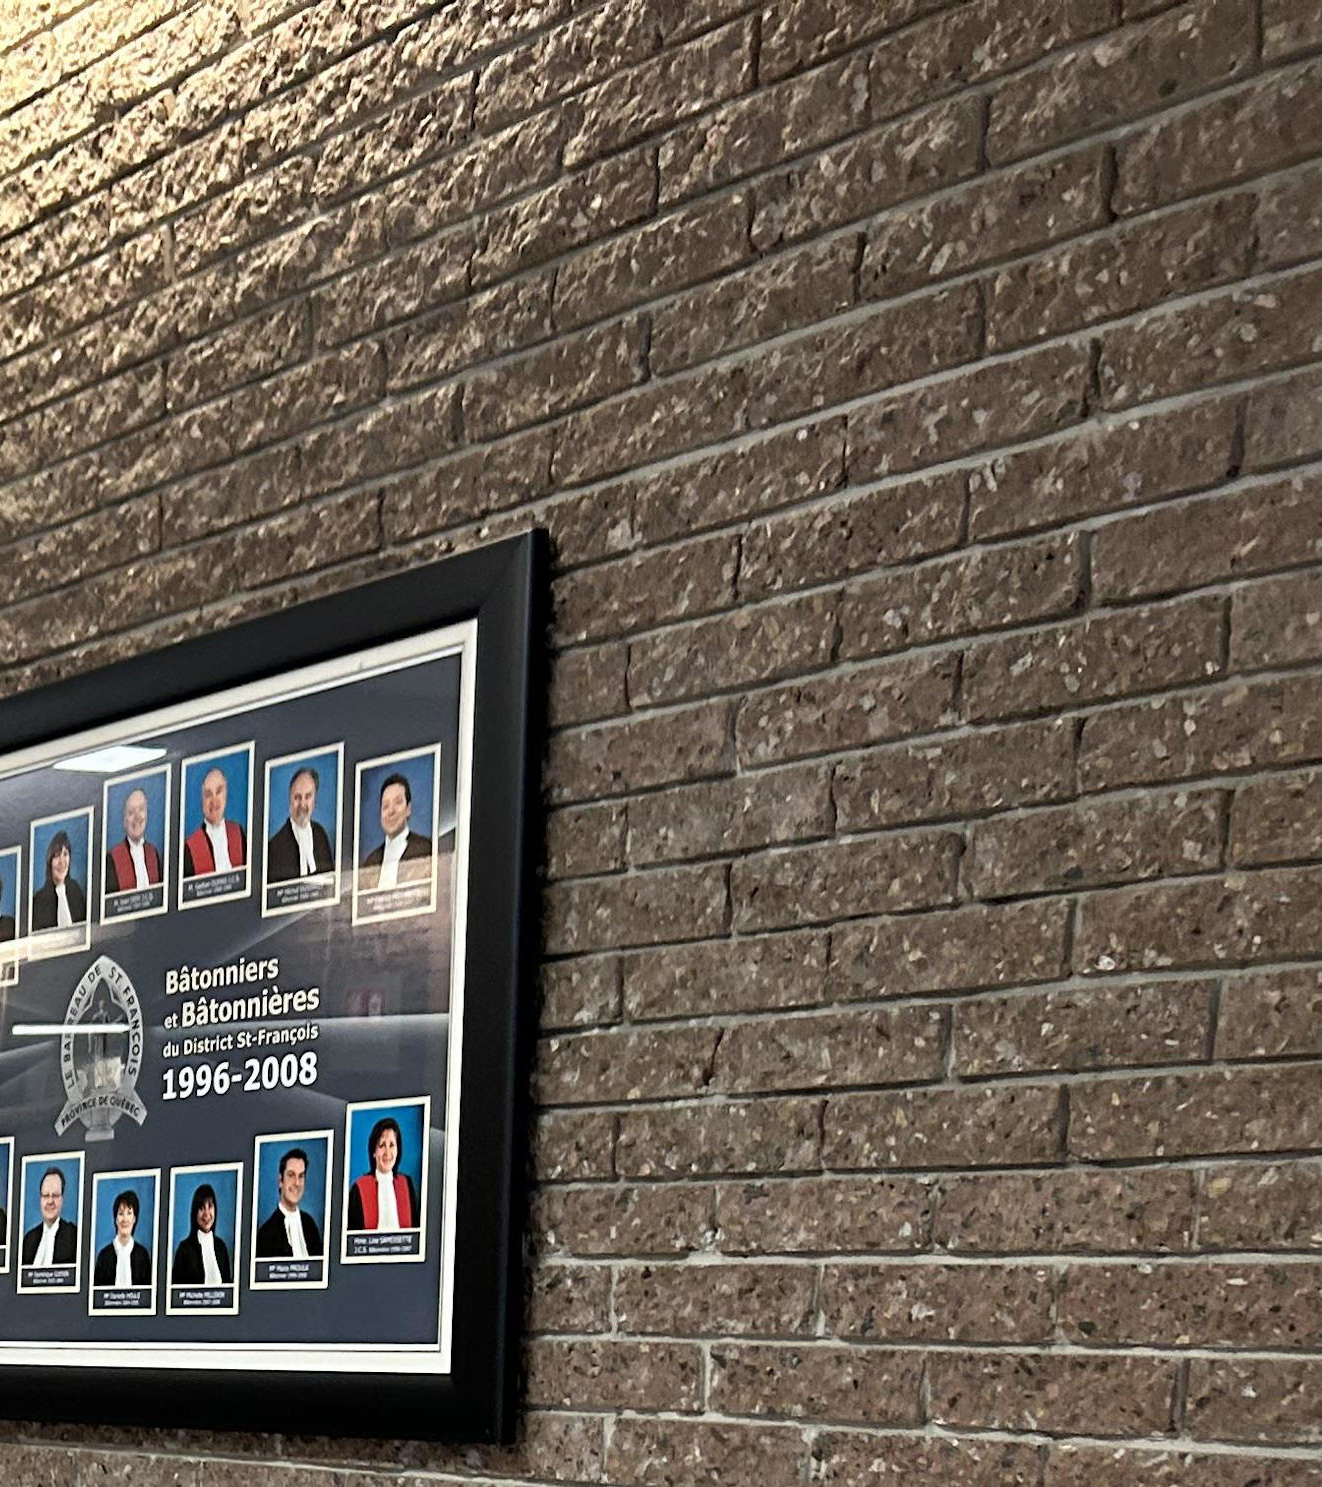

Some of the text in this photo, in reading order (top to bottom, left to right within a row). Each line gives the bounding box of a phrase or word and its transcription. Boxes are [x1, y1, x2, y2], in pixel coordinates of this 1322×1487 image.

[165, 957, 279, 995] Bâtonniers
[65, 1070, 75, 1089] LE
[87, 964, 102, 983] DE
[163, 985, 320, 1029] et Bâtonnières
[163, 1022, 319, 1058] du District St-François
[162, 1051, 318, 1100] 1996-2008
